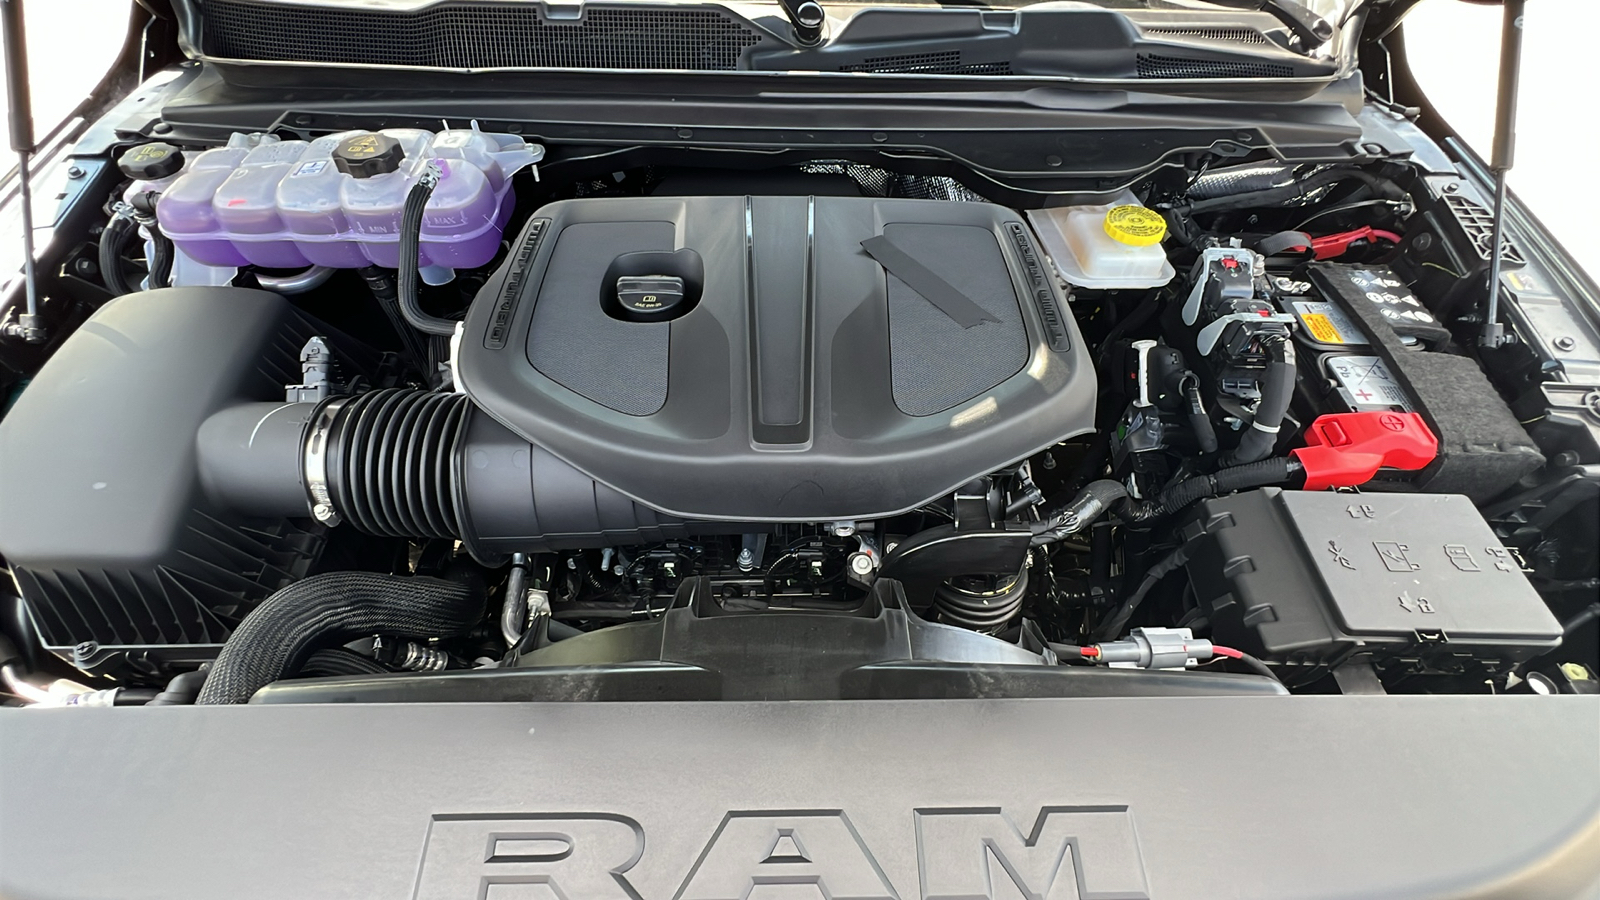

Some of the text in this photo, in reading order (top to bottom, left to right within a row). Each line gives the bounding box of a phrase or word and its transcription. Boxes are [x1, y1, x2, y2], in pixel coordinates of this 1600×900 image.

[434, 217, 456, 225] MAX
[1010, 223, 1042, 288] TURBO
[490, 267, 526, 343] TURBO
[1336, 366, 1351, 378] Pb
[411, 803, 1152, 900] RAM
